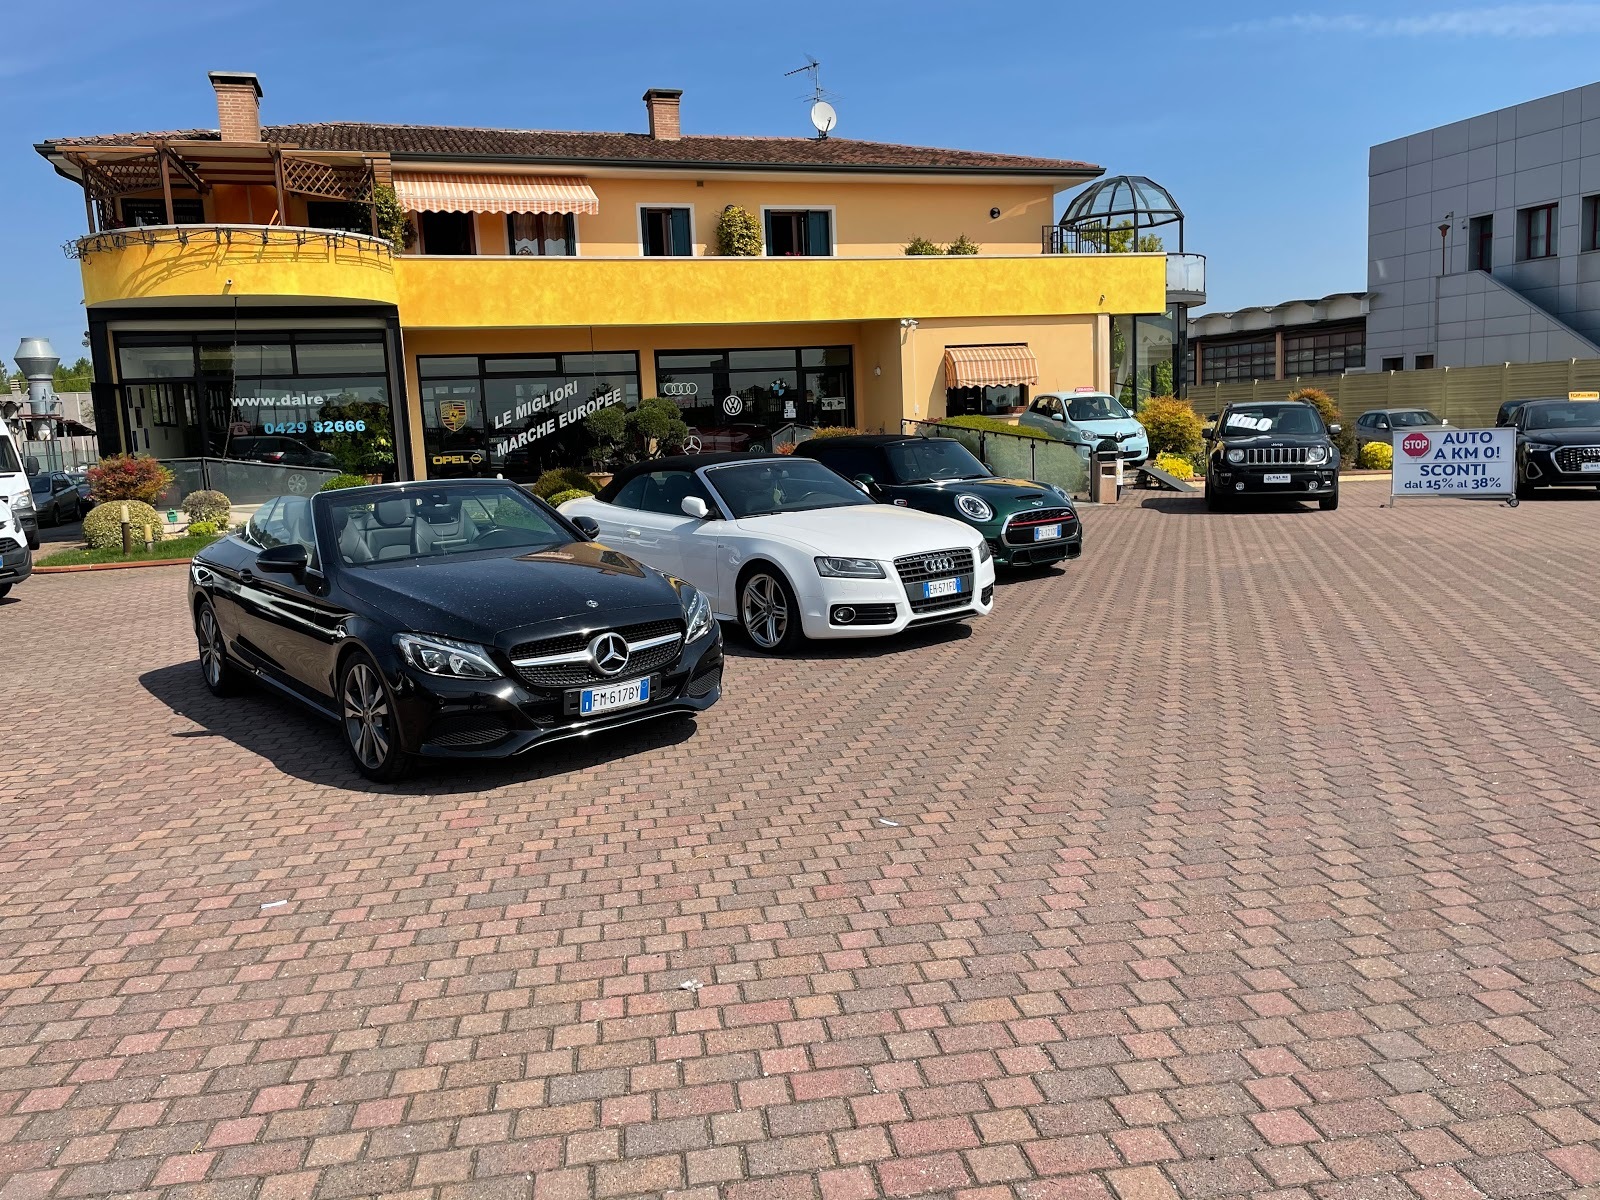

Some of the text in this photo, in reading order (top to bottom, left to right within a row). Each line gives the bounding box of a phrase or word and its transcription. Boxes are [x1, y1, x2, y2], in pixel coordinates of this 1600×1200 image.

[230, 393, 324, 407] www.dalre
[494, 380, 578, 429] LE MIGLIORI
[264, 419, 366, 435] 0429 82666
[496, 388, 622, 457] MARCHE EUROPEE
[1403, 440, 1428, 450] STOP
[1442, 431, 1493, 445] AUTO
[433, 455, 470, 464] OPEL
[1433, 451, 1447, 460] A
[1451, 447, 1478, 460] KM
[1420, 463, 1486, 477] SCONTI
[1404, 477, 1502, 490] dal 15% al 38%
